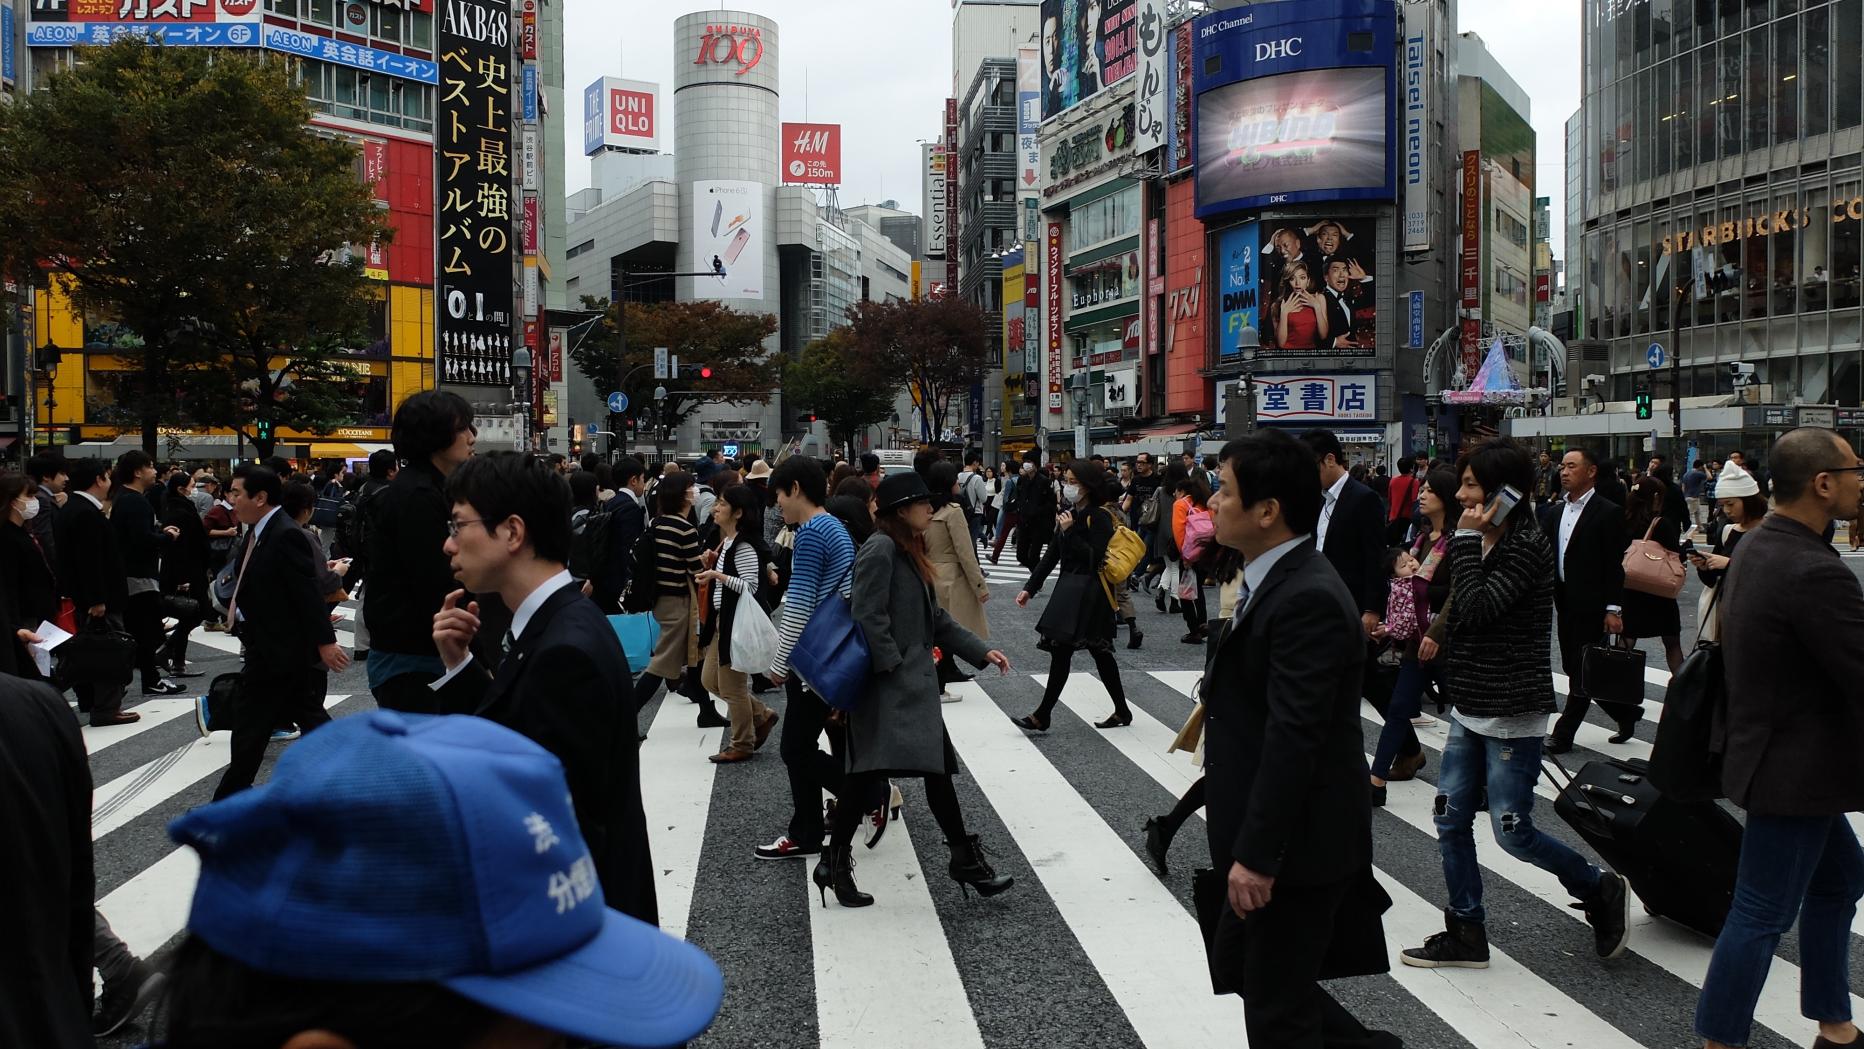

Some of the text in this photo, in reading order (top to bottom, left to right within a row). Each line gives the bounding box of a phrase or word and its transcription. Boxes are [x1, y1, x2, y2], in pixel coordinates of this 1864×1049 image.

[77, 5, 114, 14] レストラン
[35, 27, 77, 41] AEON
[230, 29, 249, 42] 6F
[441, 0, 508, 48] AKB48
[706, 25, 761, 37] SHIBUYA
[1201, 14, 1253, 38] DHC Channel
[524, 24, 535, 52] ガスト
[1255, 37, 1302, 62] DHC
[272, 31, 434, 78] AEON 英会話イーオン
[693, 33, 763, 75] 109
[1138, 3, 1164, 144] もんじゃ
[589, 89, 600, 117] THE
[615, 94, 646, 114] UNI
[1408, 30, 1424, 185] Taisei neon
[585, 112, 603, 145] PRIME
[615, 113, 649, 132] QLO
[476, 55, 509, 254] 史上最強の
[793, 130, 829, 155] H&M
[441, 46, 473, 276] ベストアルバム
[807, 160, 827, 168] この先
[807, 167, 834, 179] 150m
[1270, 195, 1288, 203] DHC
[525, 206, 533, 218] La
[929, 172, 945, 252] Essential
[1409, 212, 1424, 220] (03)
[1463, 153, 1478, 301] クスリのことなら 三千里
[1662, 207, 1810, 256] STARBUCKS
[370, 269, 383, 278] 4F
[1050, 246, 1059, 340] ウィンターフルーツギフト
[1073, 285, 1120, 308] Euphoria
[1169, 284, 1201, 322] クスリ
[1223, 288, 1256, 312] DMM
[1228, 311, 1250, 334] FX
